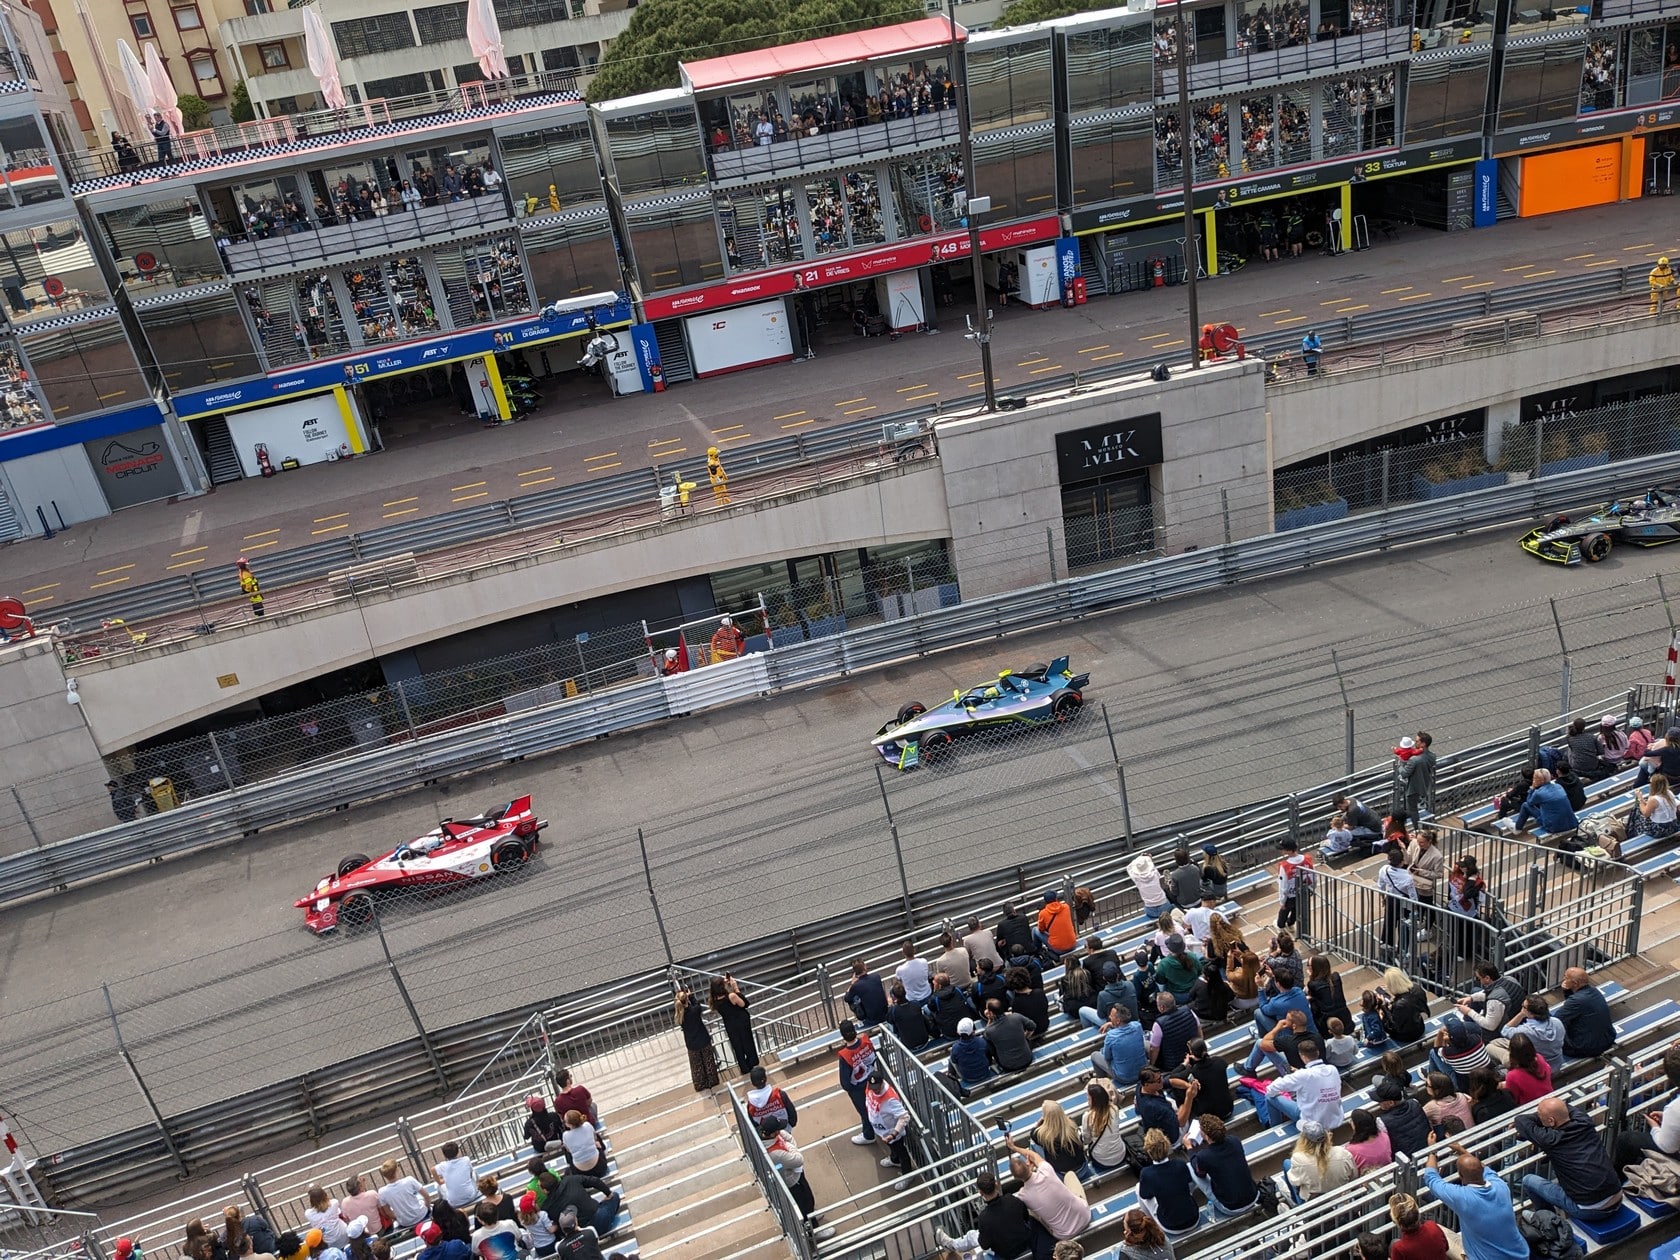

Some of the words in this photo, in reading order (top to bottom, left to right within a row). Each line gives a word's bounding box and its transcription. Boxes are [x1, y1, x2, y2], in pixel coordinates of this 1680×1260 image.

[1365, 162, 1380, 174] 33
[1383, 161, 1406, 170] TICKTUM
[1228, 188, 1238, 198] 3
[1240, 188, 1257, 196] SETTE
[941, 243, 958, 254] 48
[806, 270, 818, 282] 21
[834, 268, 850, 276] VRIES
[572, 317, 586, 326] ABT
[503, 332, 513, 342] 11
[529, 328, 550, 336] GRASSI
[423, 348, 437, 358] ABT
[614, 351, 628, 360] ABT
[355, 363, 370, 374] 51
[302, 417, 318, 429] ABT
[1081, 430, 1140, 468] MK
[1098, 444, 1123, 453] MONACO
[105, 453, 164, 474] MONACO
[116, 463, 158, 479] CIRCUIT
[402, 871, 453, 883] NISSAN
